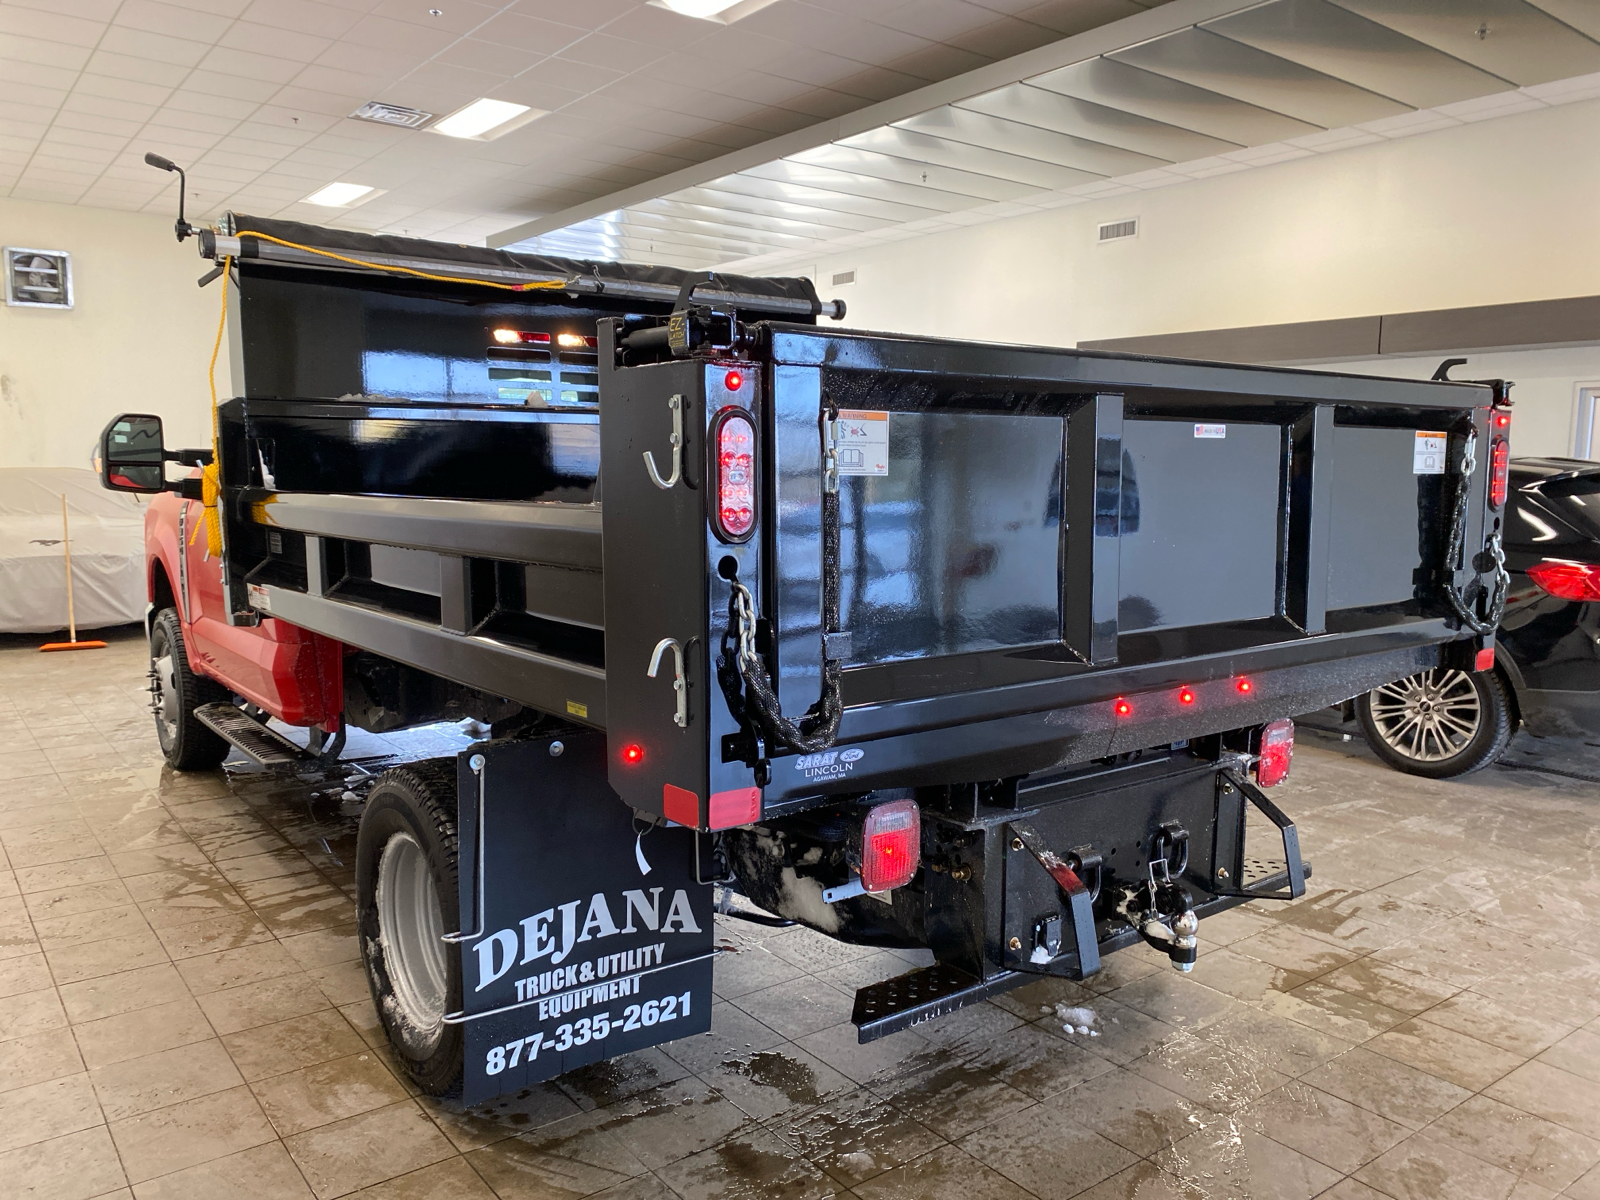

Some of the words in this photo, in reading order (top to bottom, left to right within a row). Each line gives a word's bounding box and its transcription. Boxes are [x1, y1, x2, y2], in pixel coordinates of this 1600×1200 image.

[670, 317, 685, 331] EZ-
[795, 751, 838, 770] SARAT
[805, 762, 853, 778] LINCOLN
[812, 774, 837, 783] AGAWAM,
[473, 887, 702, 992] DEJANA
[538, 975, 642, 1022] EQUIPMENT
[485, 991, 692, 1076] 877-335-2621
